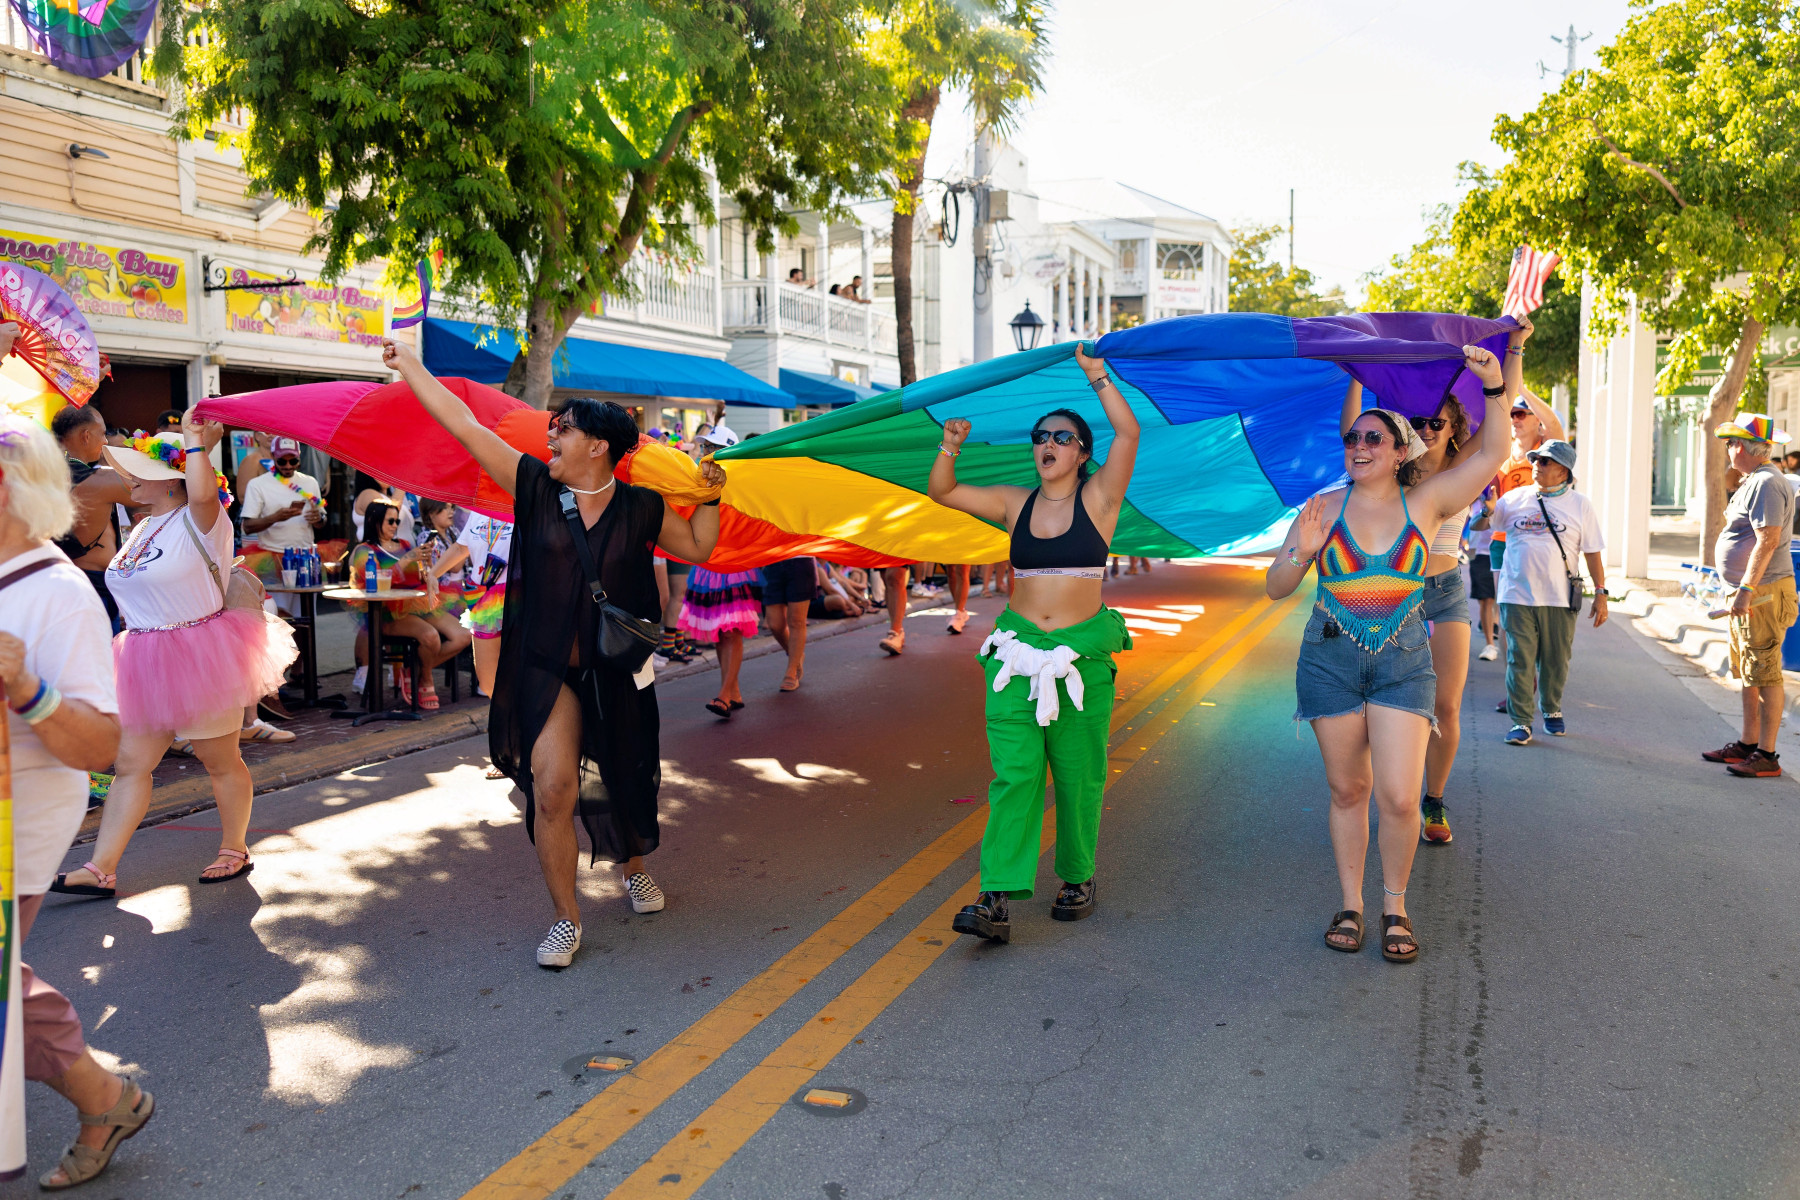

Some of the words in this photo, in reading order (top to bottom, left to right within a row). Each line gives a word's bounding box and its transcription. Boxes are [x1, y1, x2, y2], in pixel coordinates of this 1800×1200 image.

[118, 249, 178, 287] Bay
[0, 268, 92, 360] PALACE
[72, 293, 127, 316] Cream
[134, 299, 184, 322] Coffee
[341, 286, 383, 311] Bar
[232, 312, 264, 333] Juice
[274, 320, 341, 342] Sandwiches
[348, 329, 383, 347] Crepes
